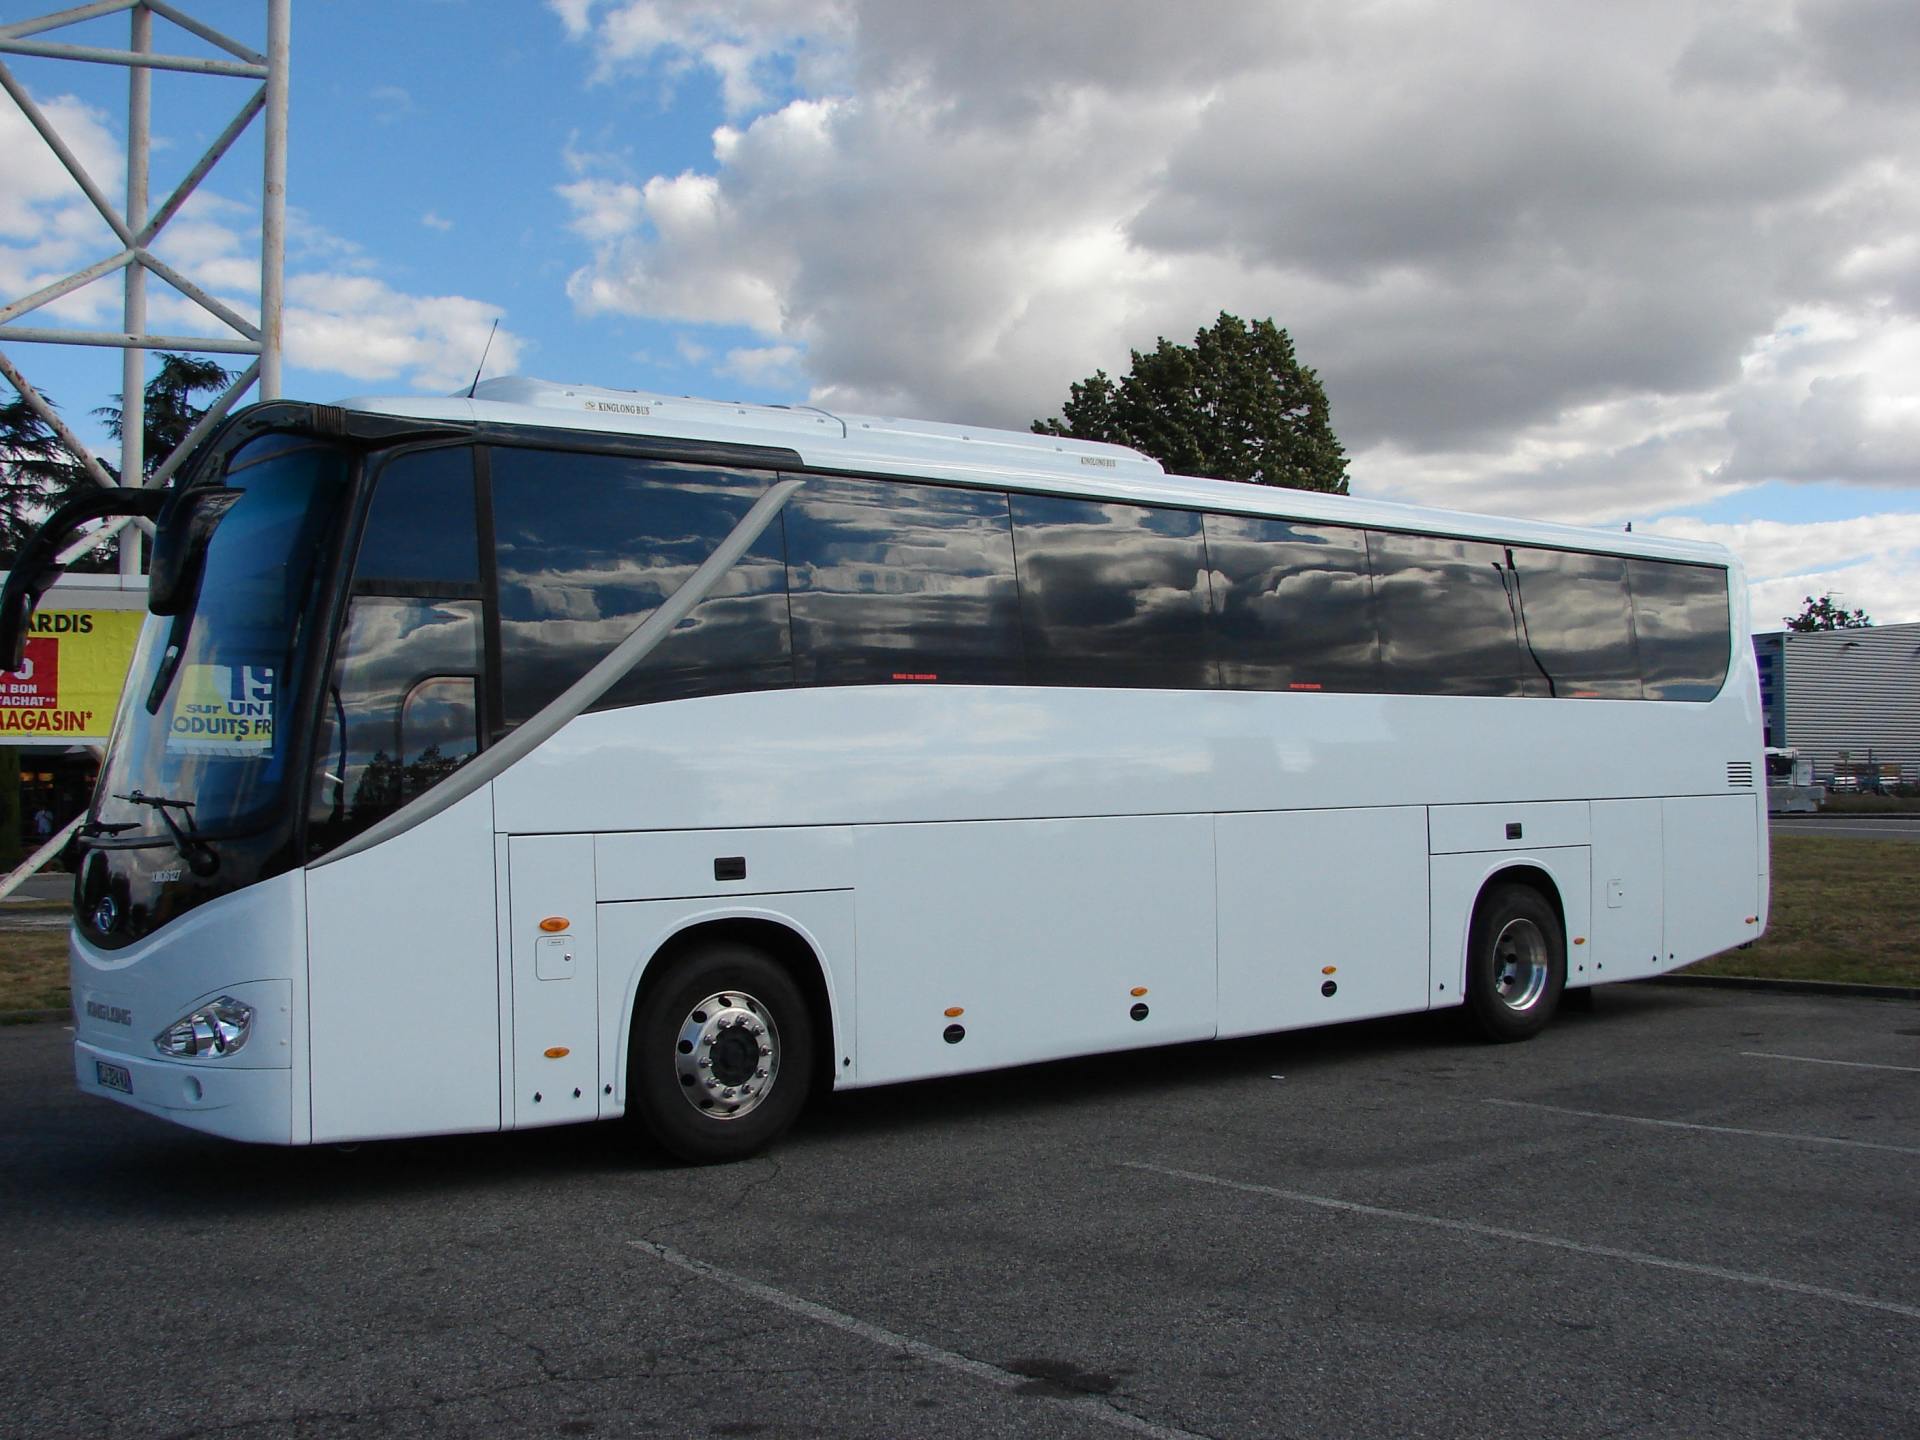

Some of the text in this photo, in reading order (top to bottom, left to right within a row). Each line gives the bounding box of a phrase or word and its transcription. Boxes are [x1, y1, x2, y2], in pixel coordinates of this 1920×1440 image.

[598, 402, 651, 415] KINGLONG BUS
[10, 684, 37, 694] BON
[185, 704, 222, 714] sur
[0, 710, 93, 731] AGASIN
[173, 716, 272, 735] ODUITS FR
